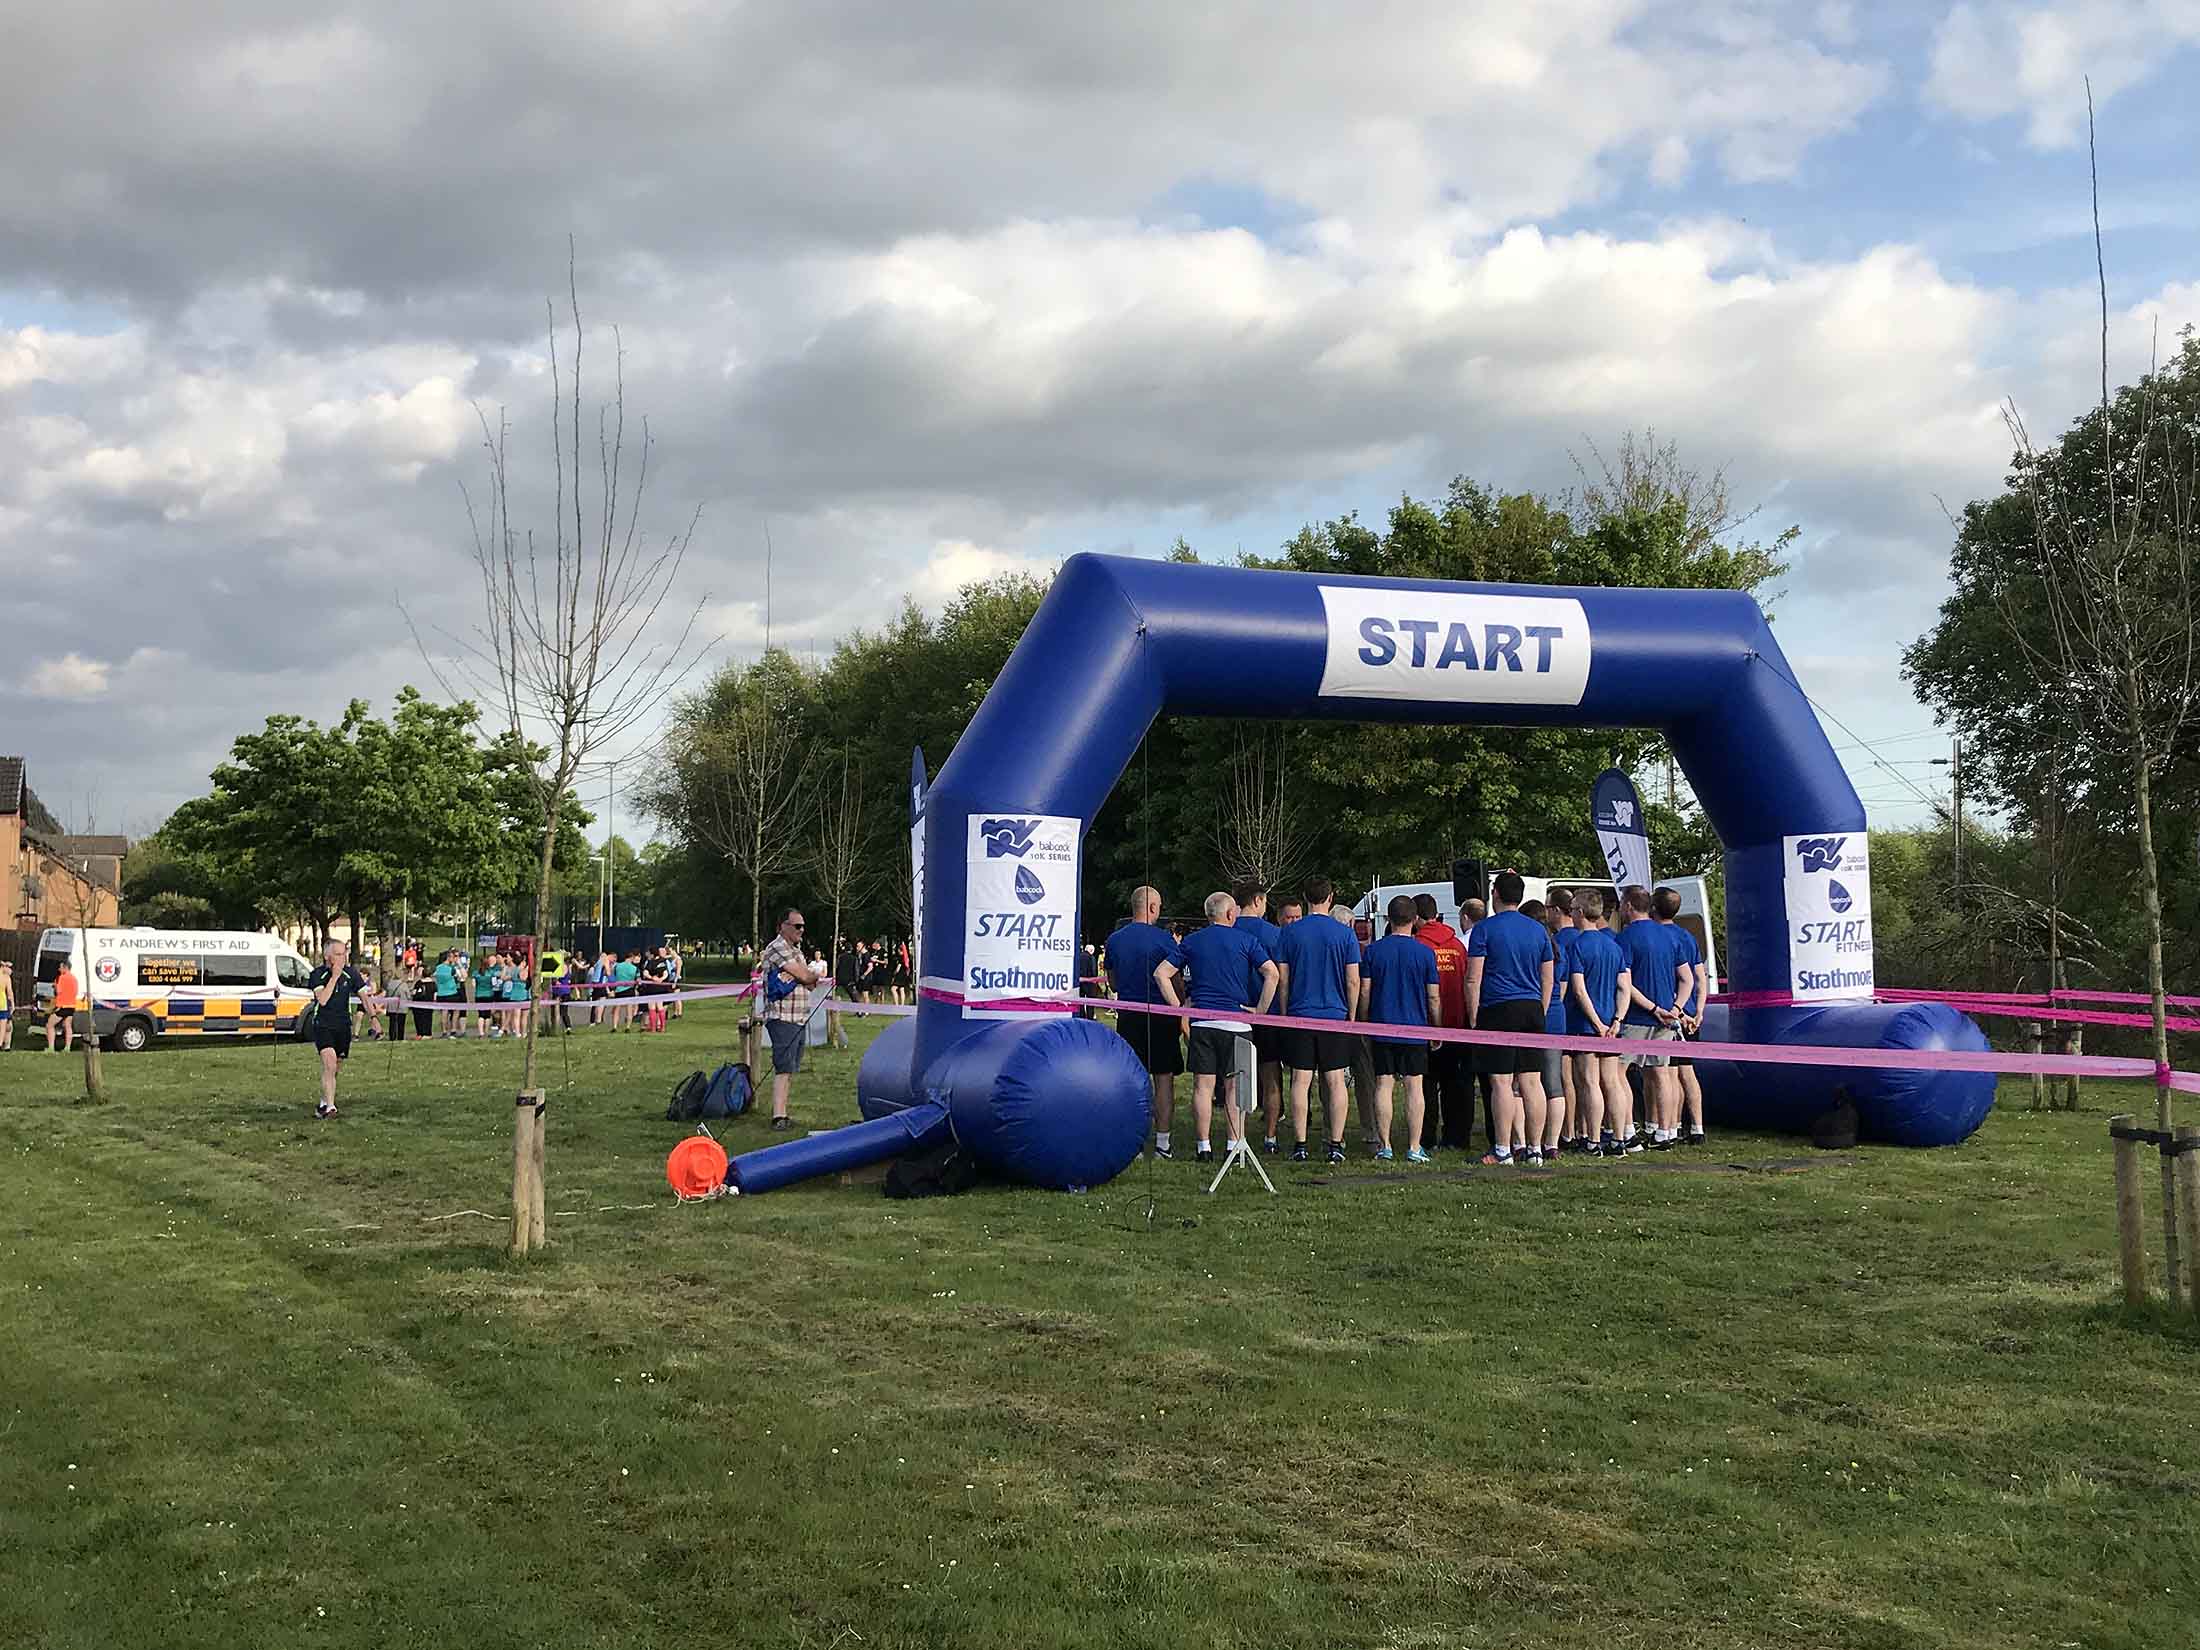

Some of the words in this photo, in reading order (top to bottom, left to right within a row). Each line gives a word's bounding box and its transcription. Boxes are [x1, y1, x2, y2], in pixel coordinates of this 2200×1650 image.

[1358, 617, 1563, 673] START
[1048, 853, 1072, 861] SERIES
[974, 913, 1062, 938] START
[1797, 920, 1865, 944] START
[98, 938, 116, 948] ST
[119, 938, 190, 950] ANDREW'S
[192, 939, 225, 950] FIRST
[228, 940, 251, 950] AID
[1017, 938, 1072, 951] FITNESS
[970, 966, 1069, 992] Strathmore
[1798, 968, 1873, 991] Strathmore
